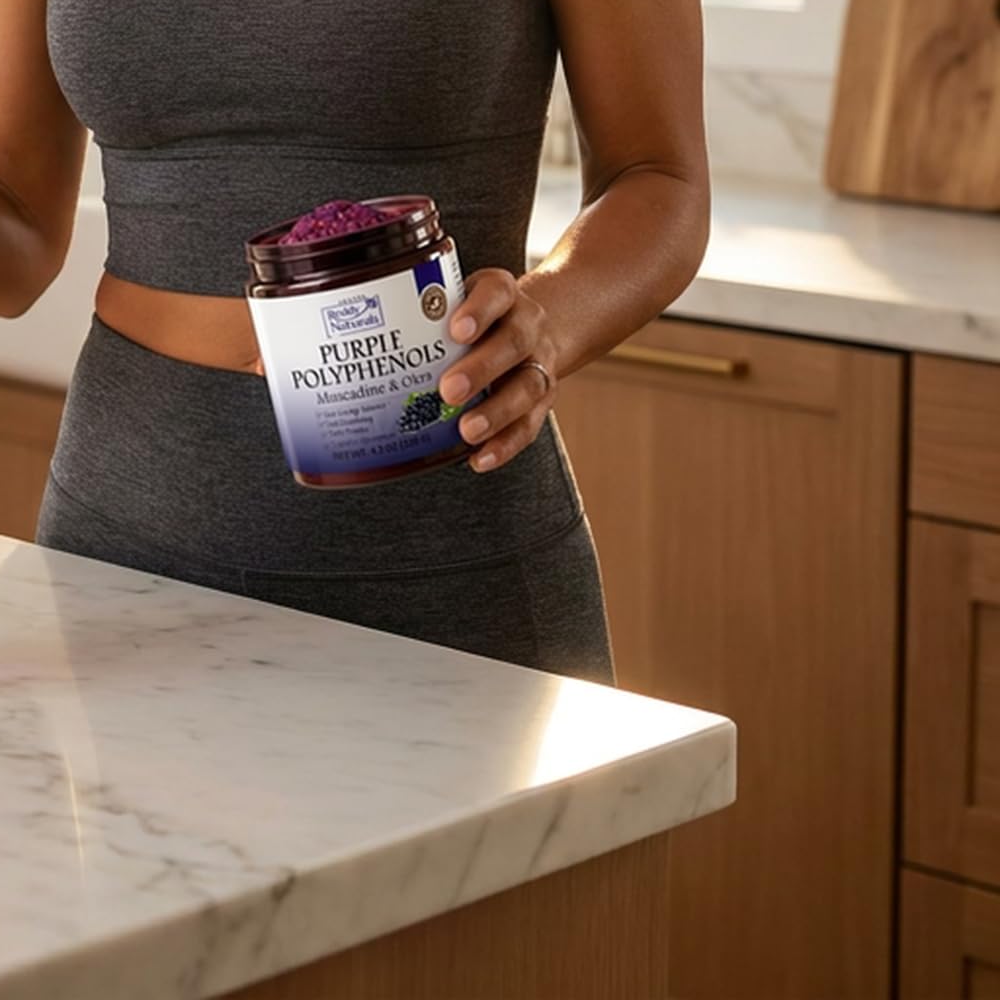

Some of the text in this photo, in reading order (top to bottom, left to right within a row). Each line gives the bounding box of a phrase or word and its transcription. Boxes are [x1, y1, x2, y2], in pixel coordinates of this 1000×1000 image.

[330, 314, 380, 332] Naturals
[291, 339, 447, 390] POLYPHENOLS
[319, 329, 403, 365] PURPLE
[316, 371, 433, 405] Muscadine & Okra
